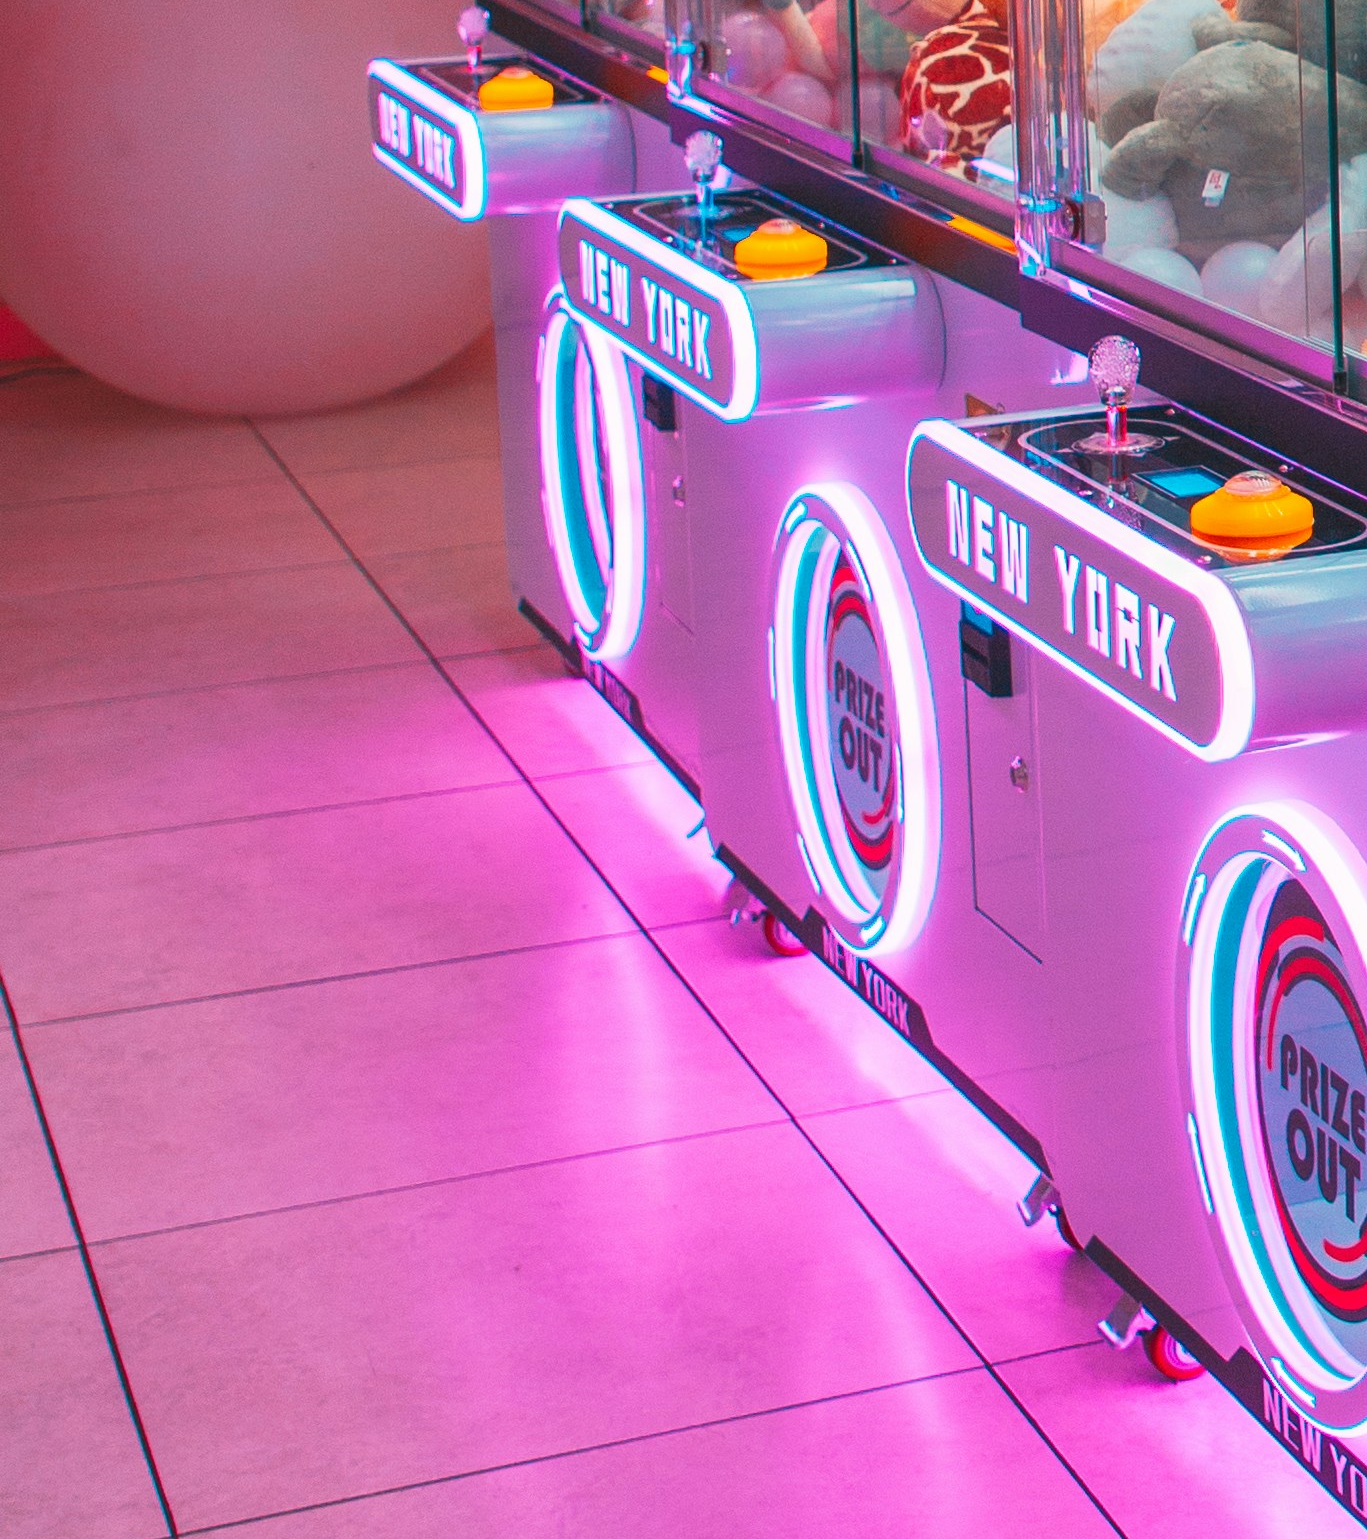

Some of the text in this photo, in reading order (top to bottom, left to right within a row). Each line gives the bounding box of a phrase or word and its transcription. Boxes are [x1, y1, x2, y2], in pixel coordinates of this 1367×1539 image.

[378, 92, 457, 189] NEW YORK
[579, 240, 711, 380] NEW YORK
[946, 480, 1177, 702] NEW YORK
[834, 658, 885, 733] PRIZE
[838, 717, 884, 792] OUT
[822, 925, 911, 1036] NEW YORK
[1279, 1033, 1367, 1155] PRIZE
[1286, 1107, 1362, 1225] OUT
[1263, 1379, 1323, 1473] NEW
